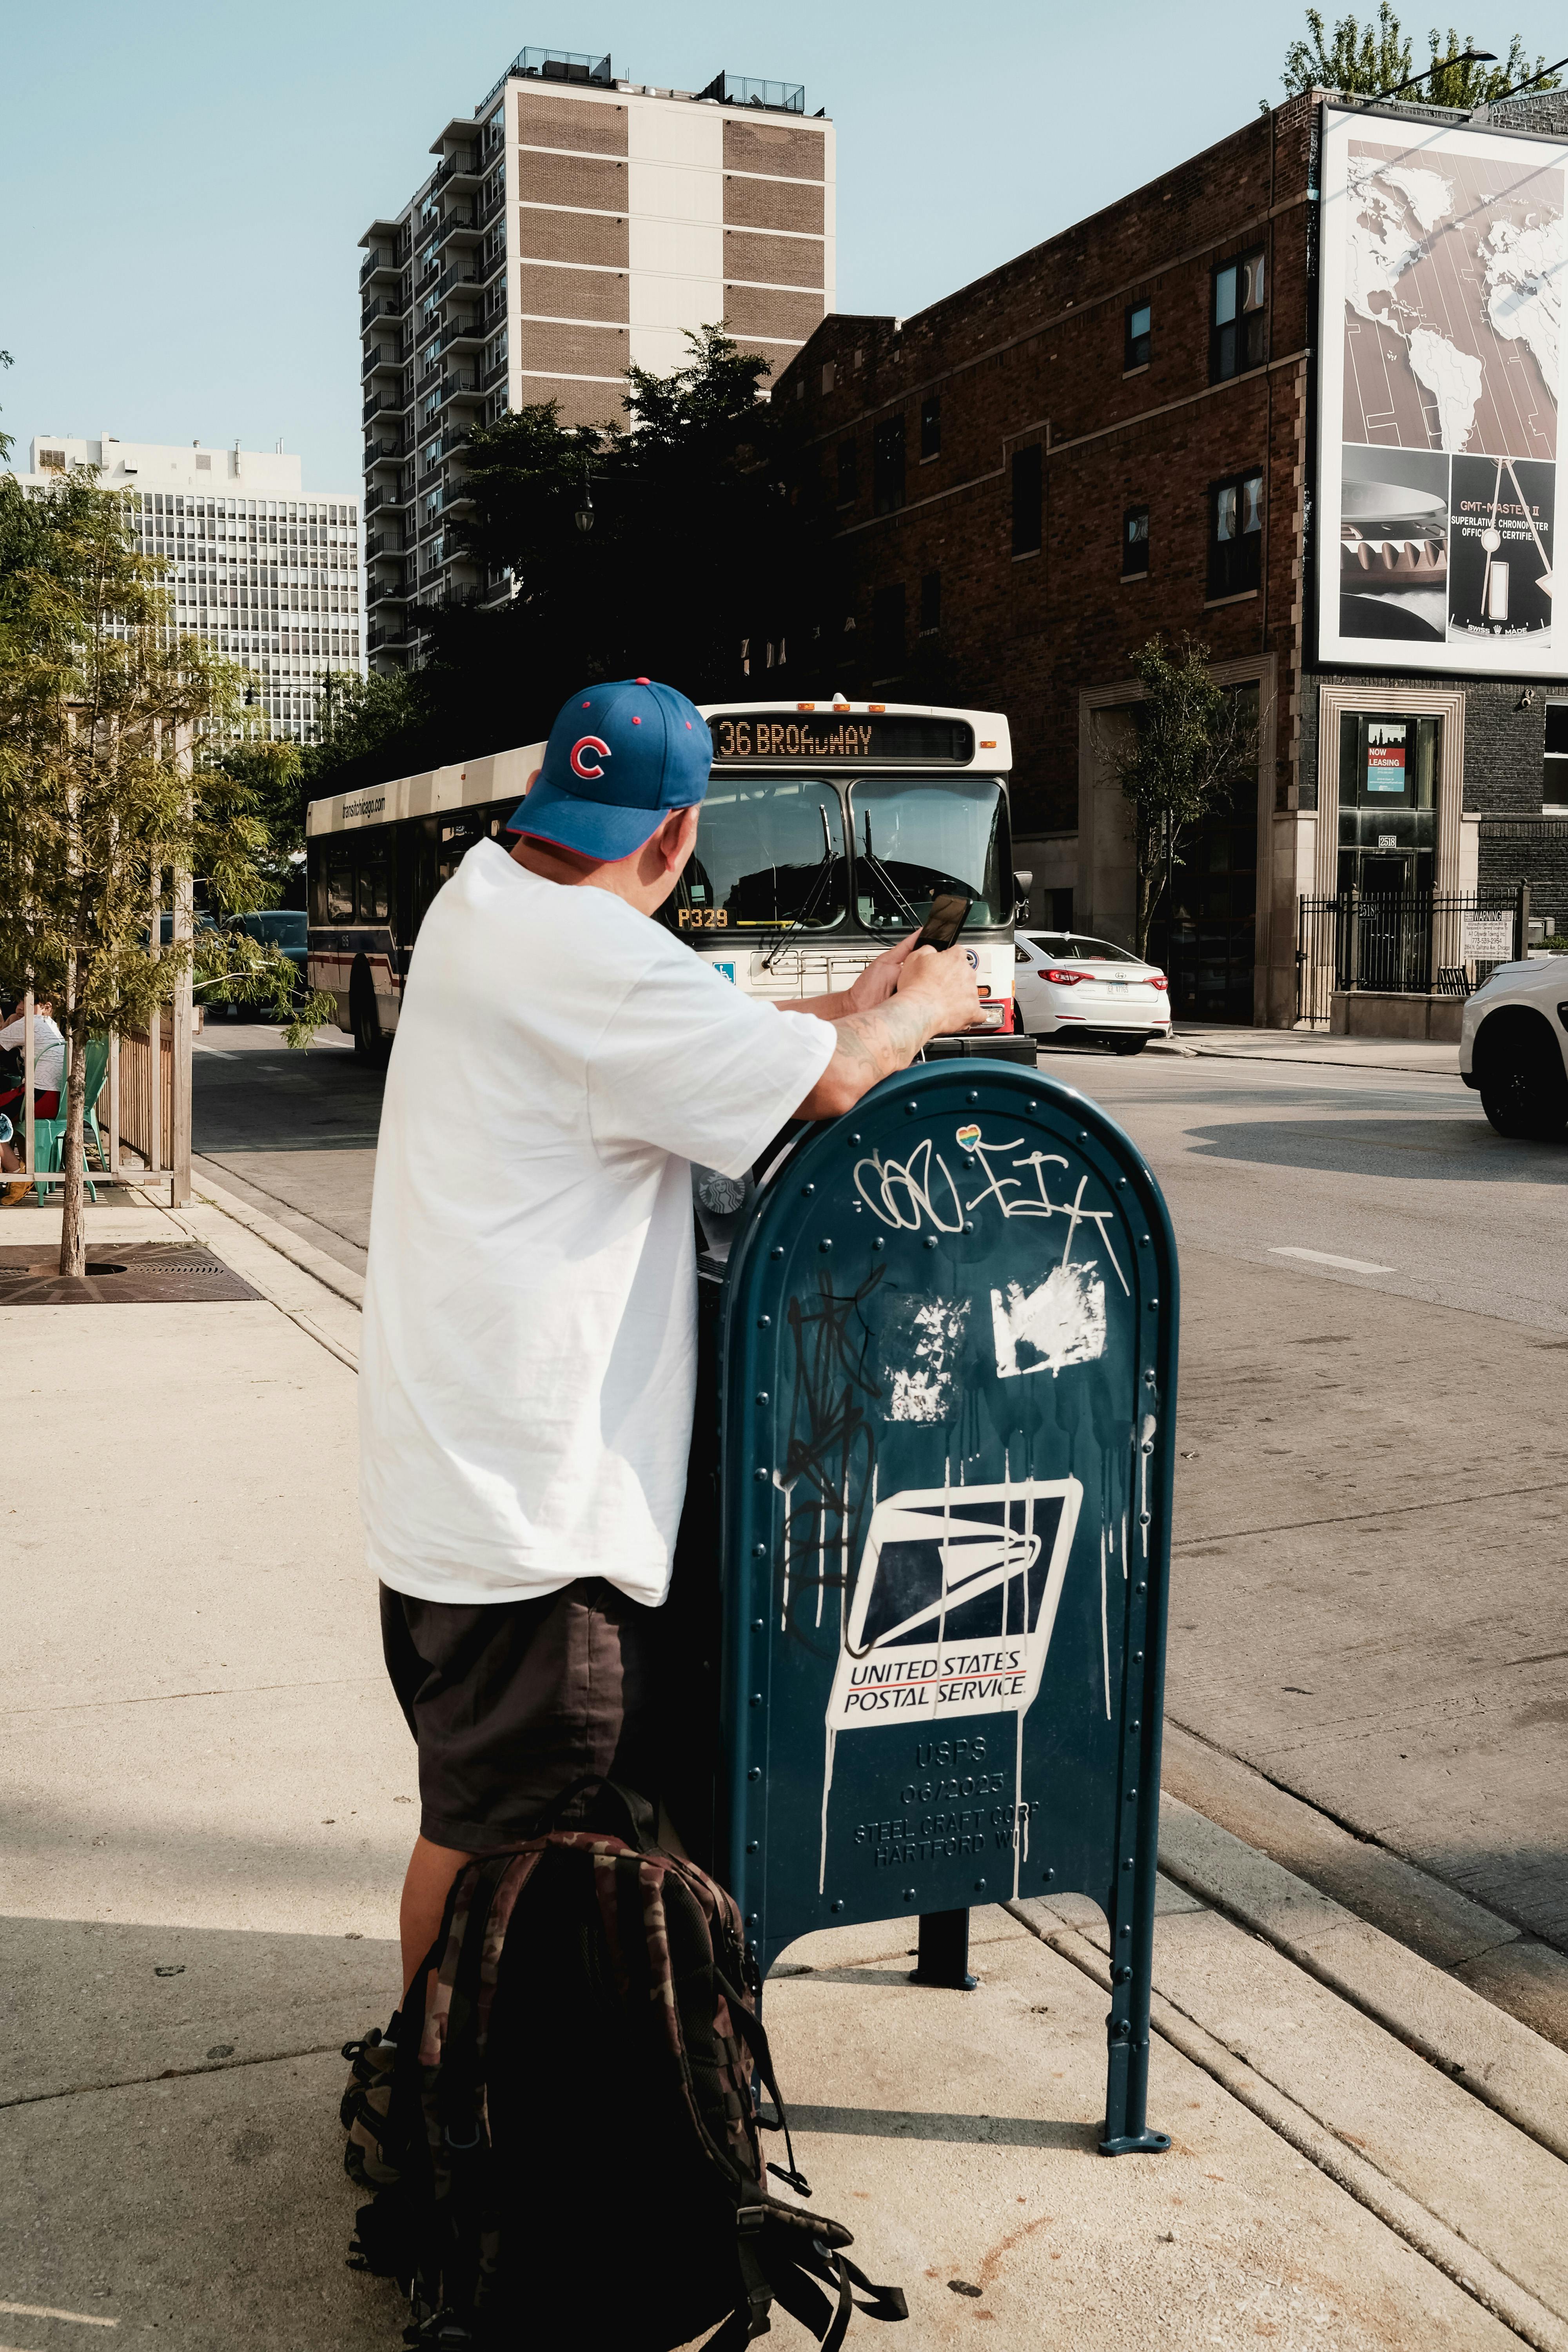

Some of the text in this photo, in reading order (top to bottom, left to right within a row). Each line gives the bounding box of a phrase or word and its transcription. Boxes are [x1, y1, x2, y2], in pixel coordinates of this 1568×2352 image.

[1468, 624, 1490, 634] SWISS
[719, 721, 751, 755] 36
[570, 736, 611, 779] C
[343, 797, 385, 819] transitchicago.com
[1379, 837, 1395, 846] 2518
[679, 909, 728, 927] P329
[1359, 904, 1374, 916] 2518
[1474, 910, 1501, 921] WARNING
[851, 1650, 1020, 1686] UNITED STATES
[844, 1676, 1026, 1713] POSTAL SERVICE
[916, 1737, 987, 1769] USPS
[854, 1801, 1040, 1844] STEEL CRAFT CORP
[874, 1833, 985, 1867] HARTFORD
